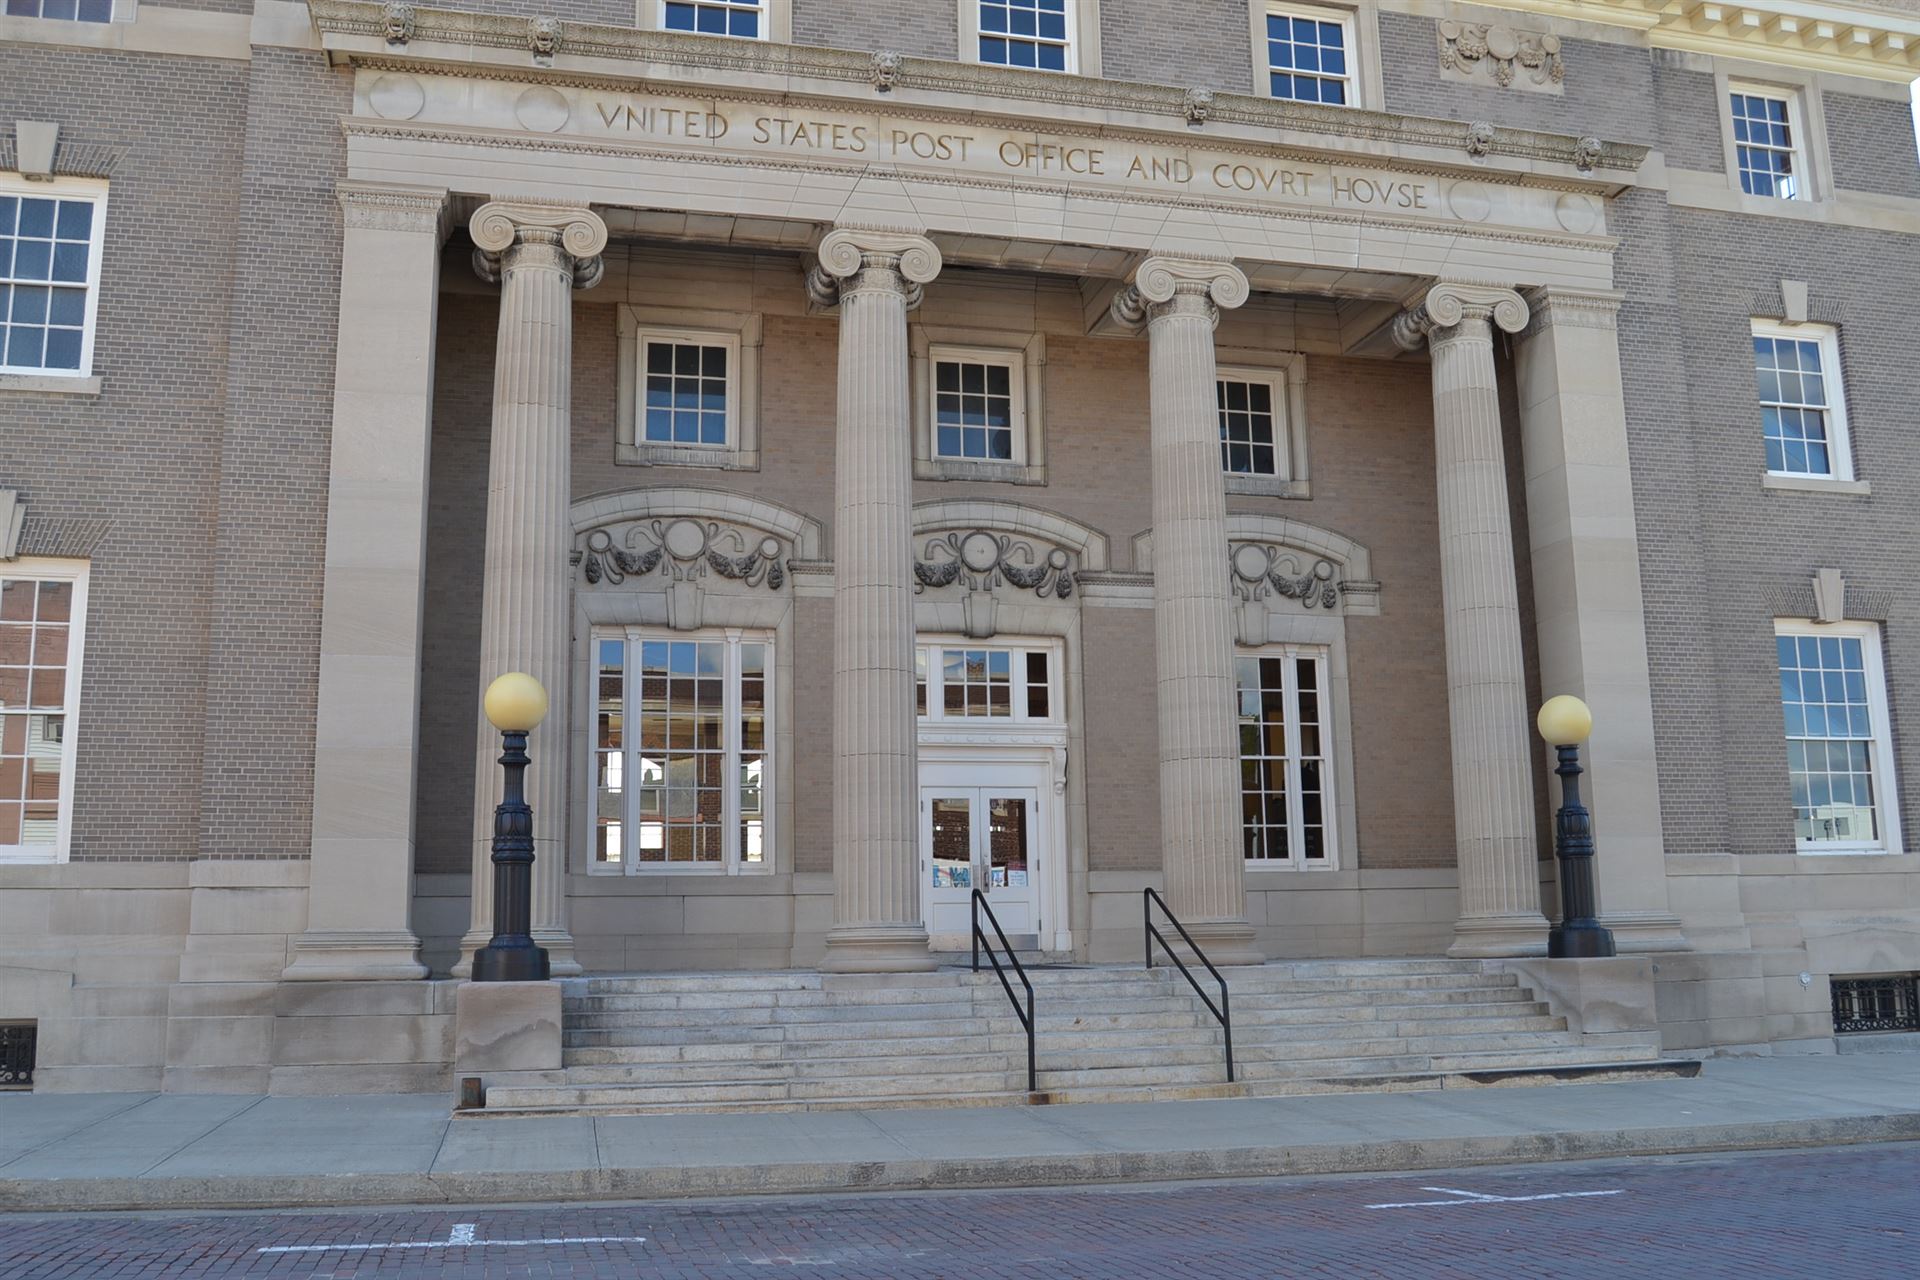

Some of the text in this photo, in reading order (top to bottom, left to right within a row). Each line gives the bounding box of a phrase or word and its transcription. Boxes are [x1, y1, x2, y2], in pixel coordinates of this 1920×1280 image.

[596, 102, 1428, 209] VNITED STATES POST OFFICE AND COVRT HOVSE
